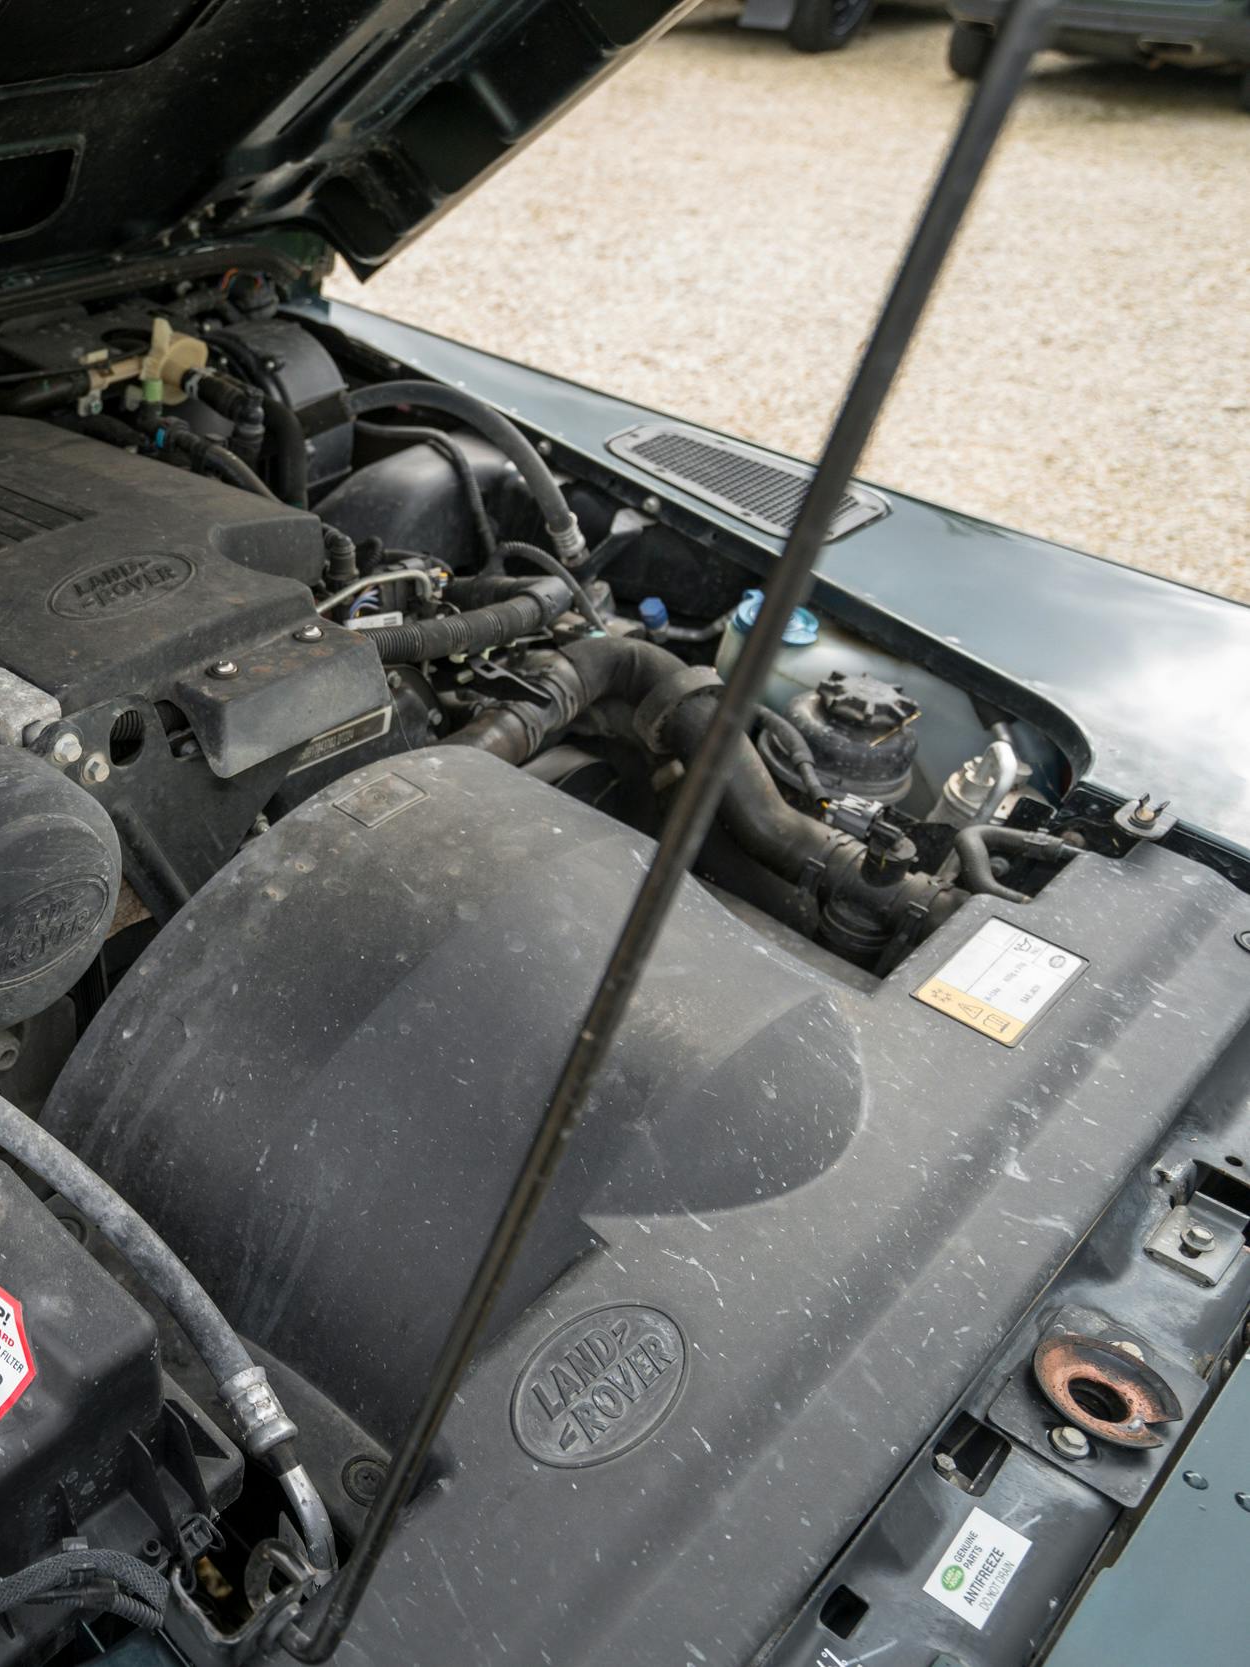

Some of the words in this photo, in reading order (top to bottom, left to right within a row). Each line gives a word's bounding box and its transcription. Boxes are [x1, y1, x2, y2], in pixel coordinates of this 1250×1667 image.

[73, 562, 141, 597] LAND
[96, 564, 178, 607] ROVER
[3, 908, 91, 970] ROVER
[0, 1349, 24, 1373] FILTER
[531, 1328, 619, 1422] LAND
[570, 1334, 678, 1445] ROVER
[953, 1530, 978, 1563] GENUINE
[962, 1545, 983, 1570] PARTS
[963, 1547, 1005, 1606] ANTIFREEZE
[978, 1596, 994, 1612] DO
[986, 1581, 1000, 1599] NOT
[994, 1560, 1015, 1585] DRAIN
